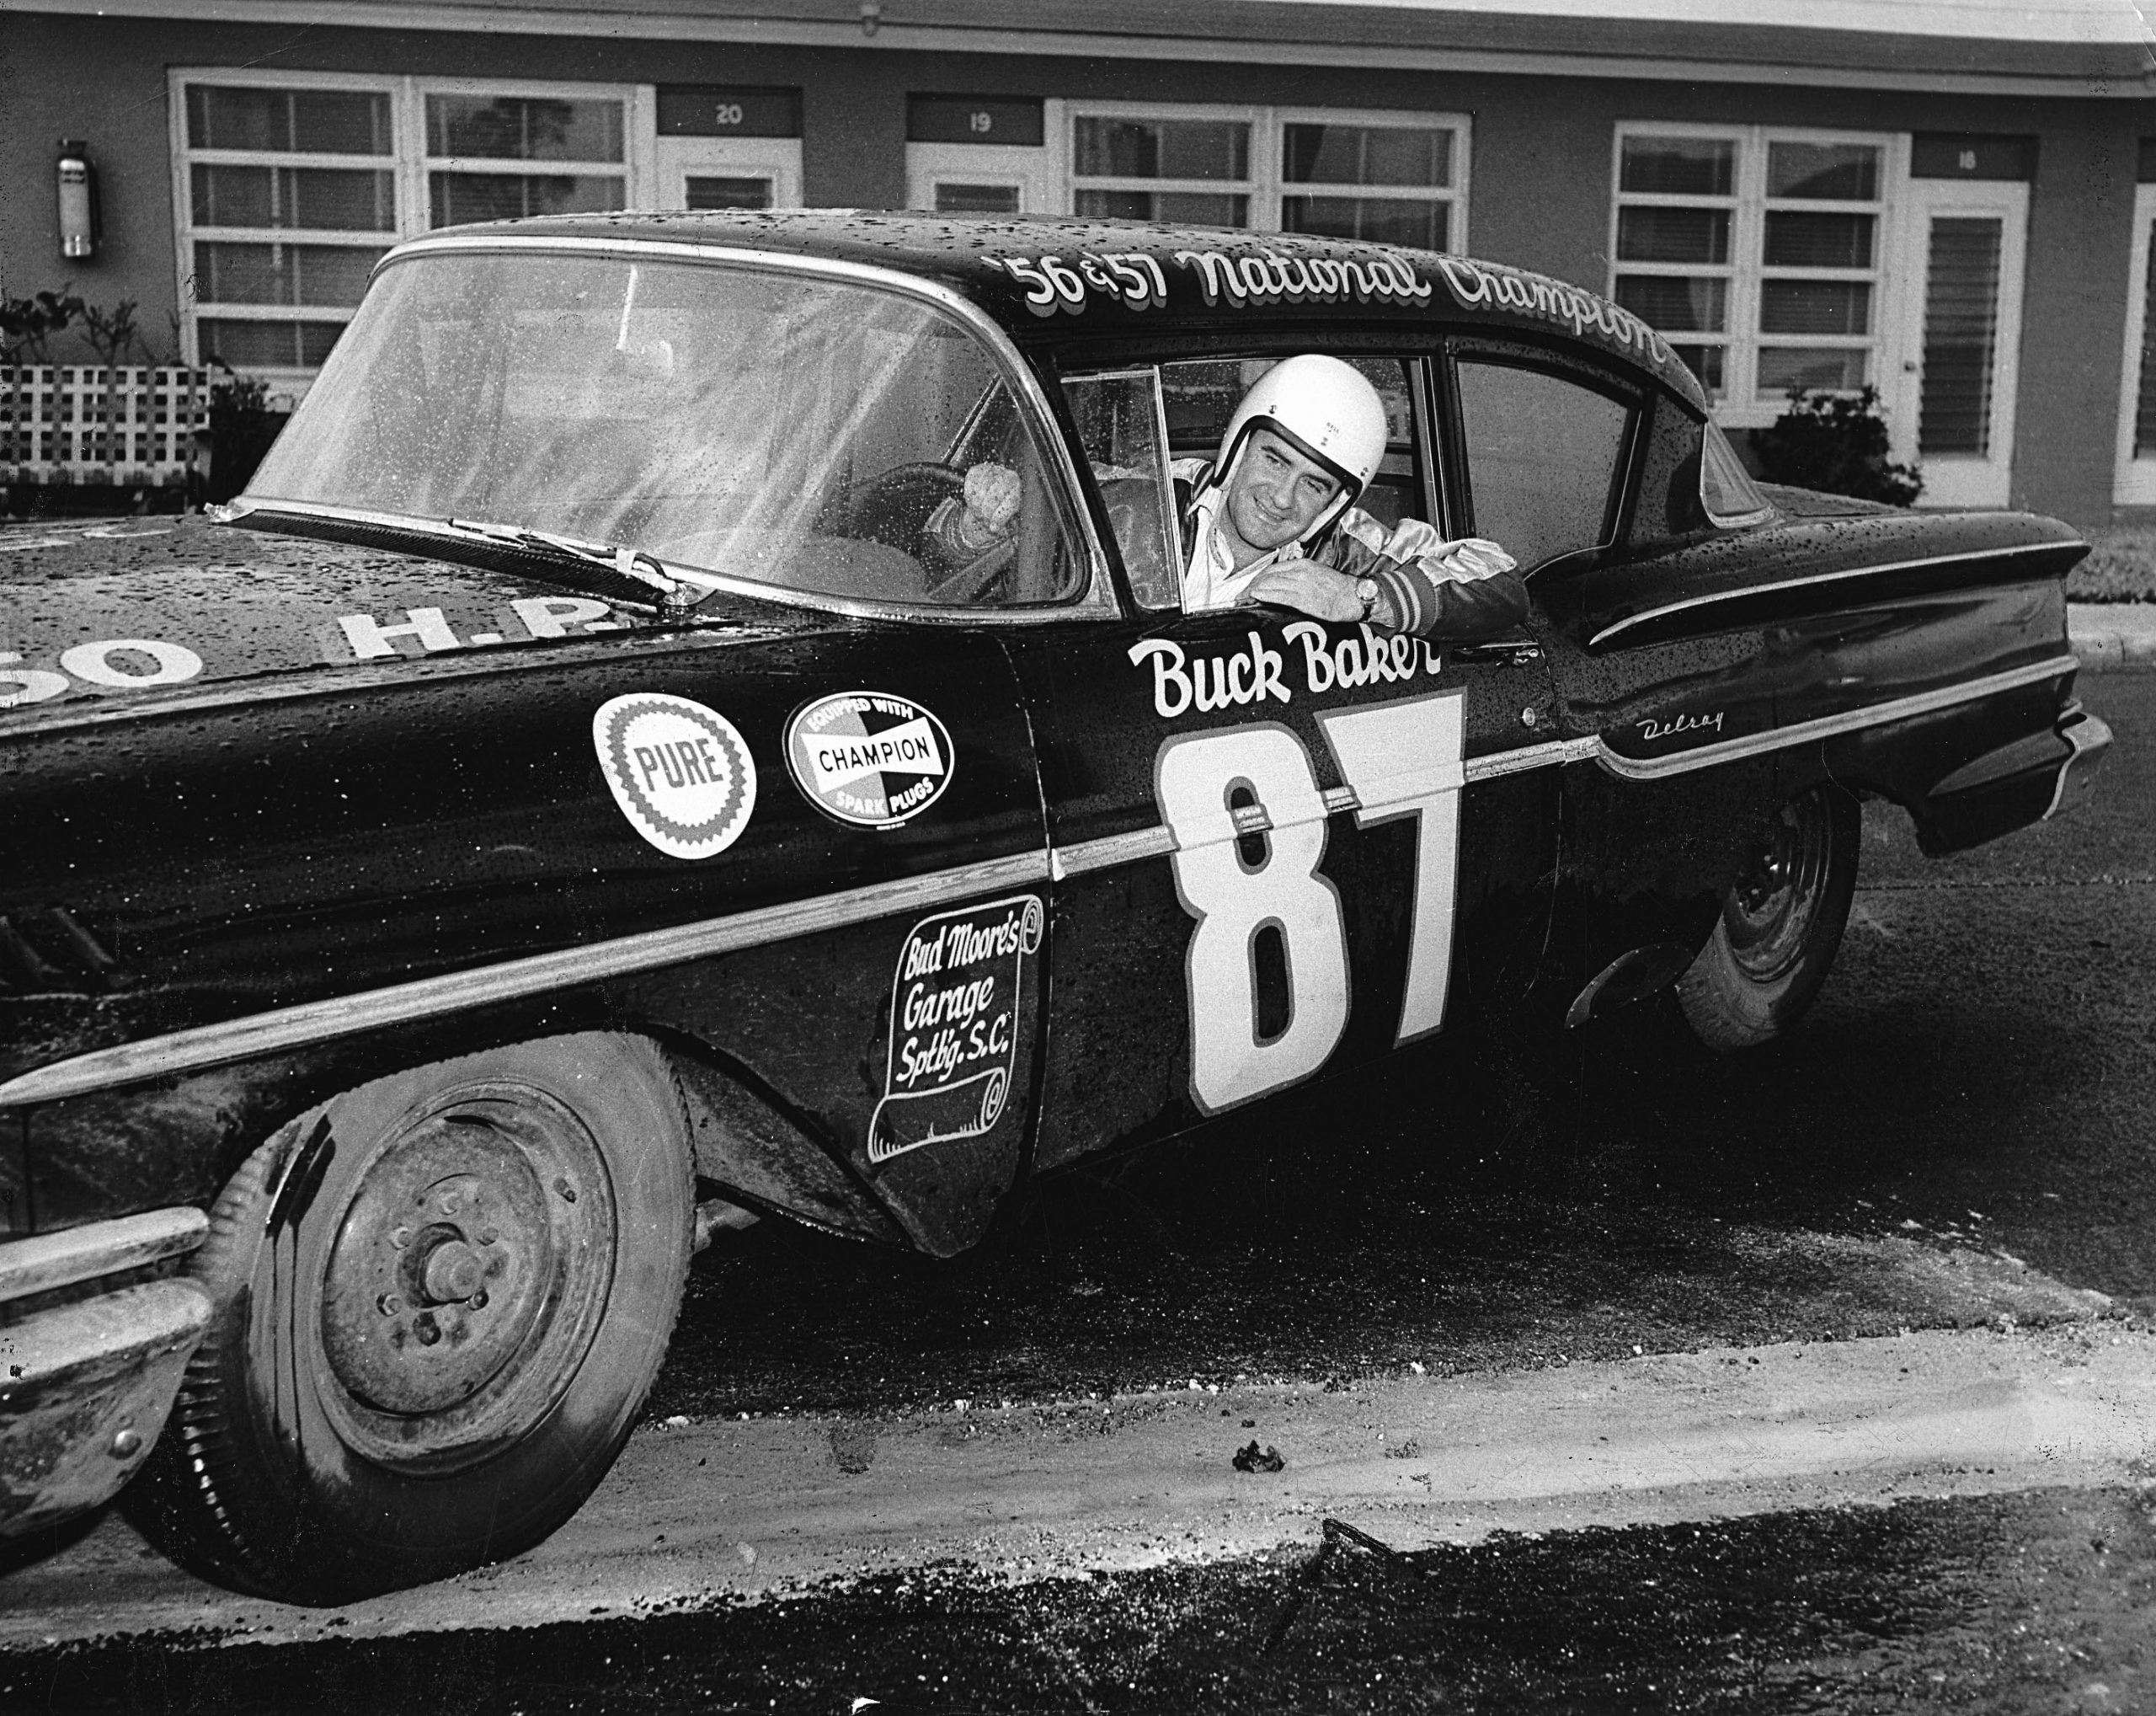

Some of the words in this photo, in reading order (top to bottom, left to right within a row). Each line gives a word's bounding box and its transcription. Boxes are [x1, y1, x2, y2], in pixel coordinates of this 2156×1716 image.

[716, 104, 743, 124] 20
[970, 112, 991, 132] 19
[1959, 150, 1977, 169] 18
[1174, 248, 1432, 297] National
[1438, 255, 1667, 364] Champion
[338, 596, 618, 659] H.P.
[1127, 631, 1292, 718] Buck
[1281, 621, 1441, 692] Baker
[806, 698, 871, 732] EQUIPPED
[871, 698, 914, 720] WITH
[1636, 712, 1724, 740] Delray
[633, 738, 723, 792] PURE
[819, 736, 931, 772] CHAMPION
[835, 790, 887, 815] SPARK
[889, 777, 934, 813] PLUGS
[1154, 686, 1468, 1117] 87
[905, 925, 947, 981] Bud
[947, 910, 1020, 969] Moore's
[904, 976, 994, 1031] Garage
[967, 1013, 1009, 1060] S.C.
